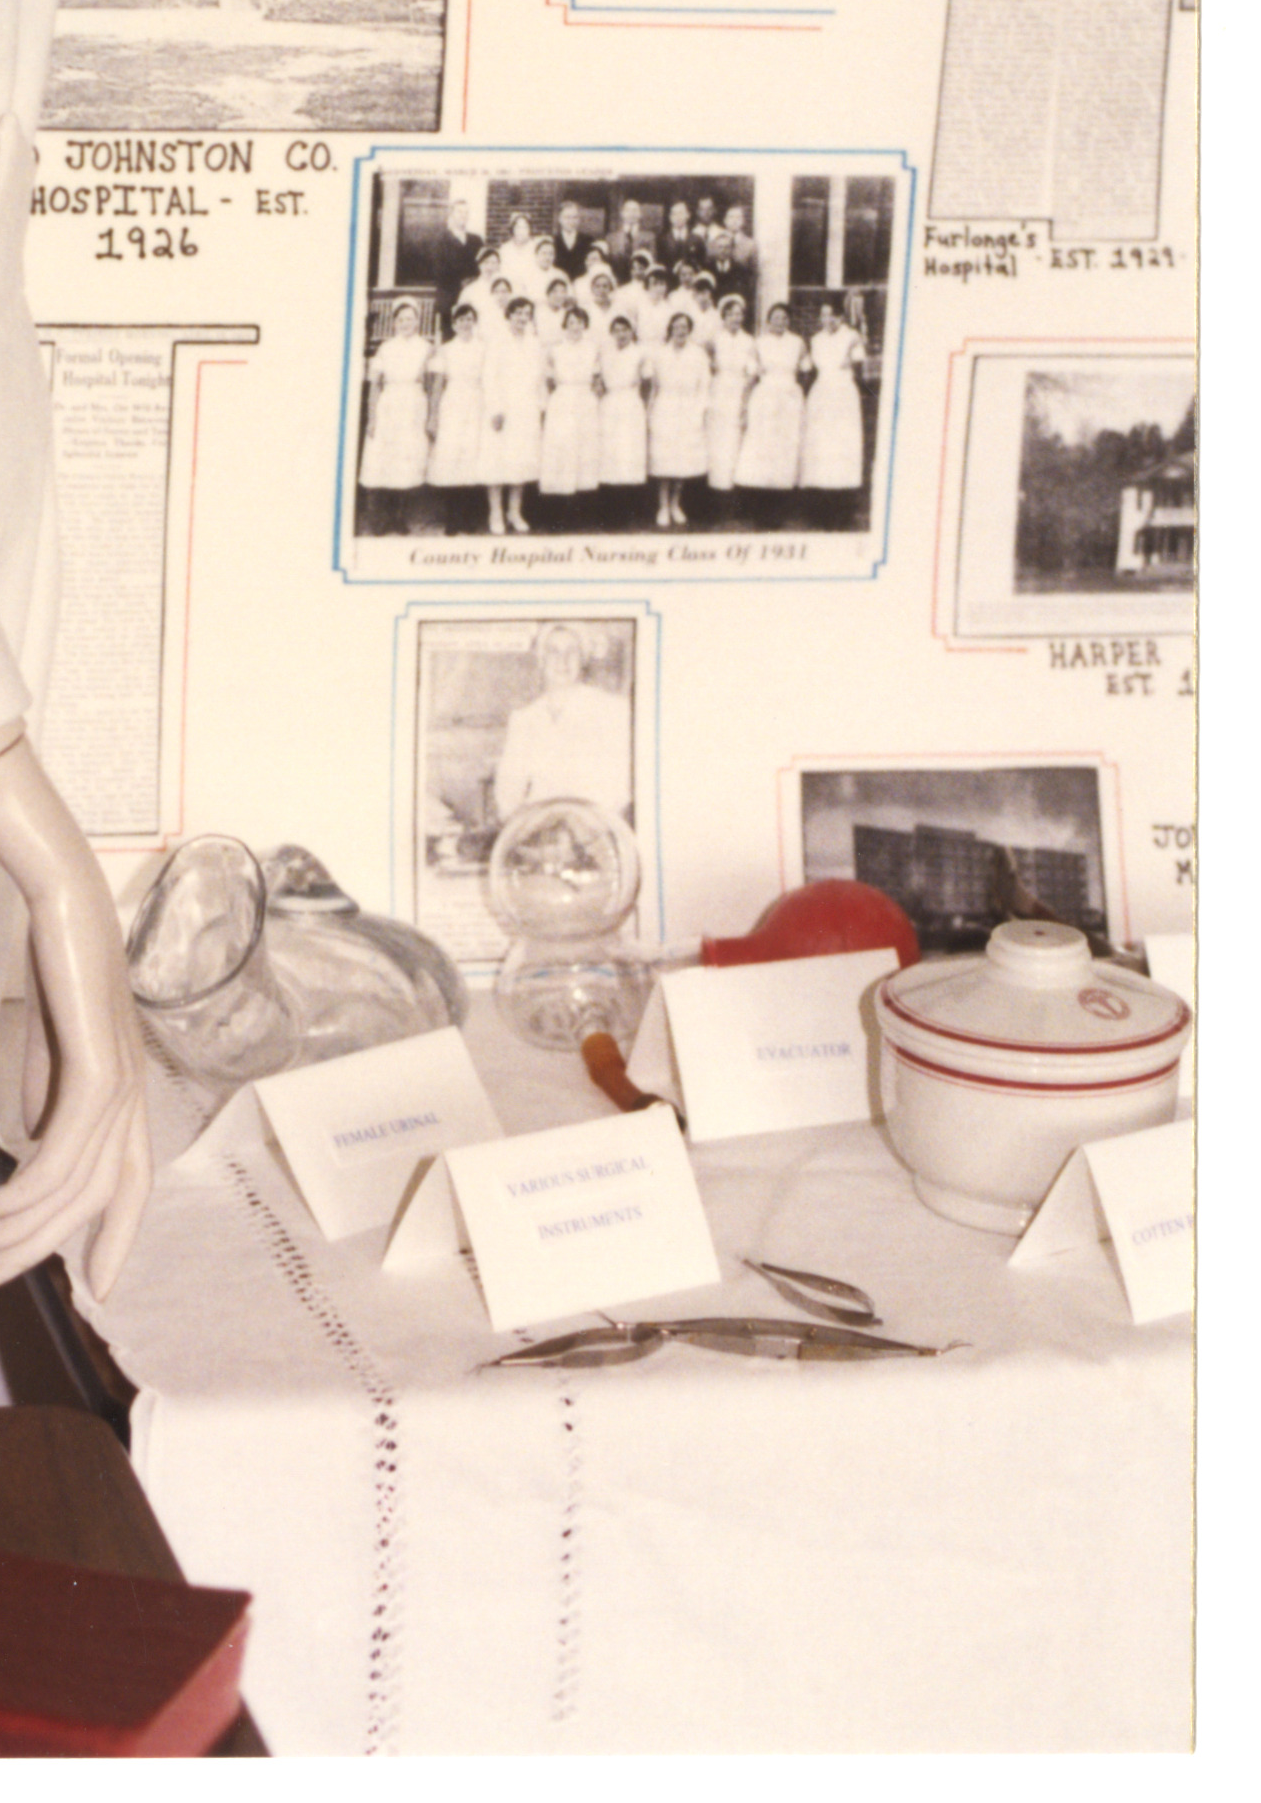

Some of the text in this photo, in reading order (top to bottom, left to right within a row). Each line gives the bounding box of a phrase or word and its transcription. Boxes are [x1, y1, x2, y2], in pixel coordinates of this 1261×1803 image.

[64, 139, 254, 173] JOHNSTON
[284, 140, 337, 173] CO.
[30, 183, 209, 217] HOSPITAL
[256, 189, 308, 216] EST.
[95, 226, 199, 261] 1926
[924, 222, 1037, 259] Furlonge's
[924, 254, 1017, 283] Hospital
[1110, 247, 1175, 269] 1929
[56, 348, 163, 368] Formal Opening
[62, 371, 117, 389] Hospital
[409, 543, 808, 569] County Hospital Nursing Class Of 1931
[1048, 640, 1162, 668] HARPER
[1151, 823, 1195, 848] JO
[755, 1041, 851, 1060] EVACUATOR
[332, 1111, 440, 1148] FEMALE URINAL
[506, 1155, 647, 1197] VARIOUS SURGICAL
[537, 1205, 644, 1239] INSTRUMENTS
